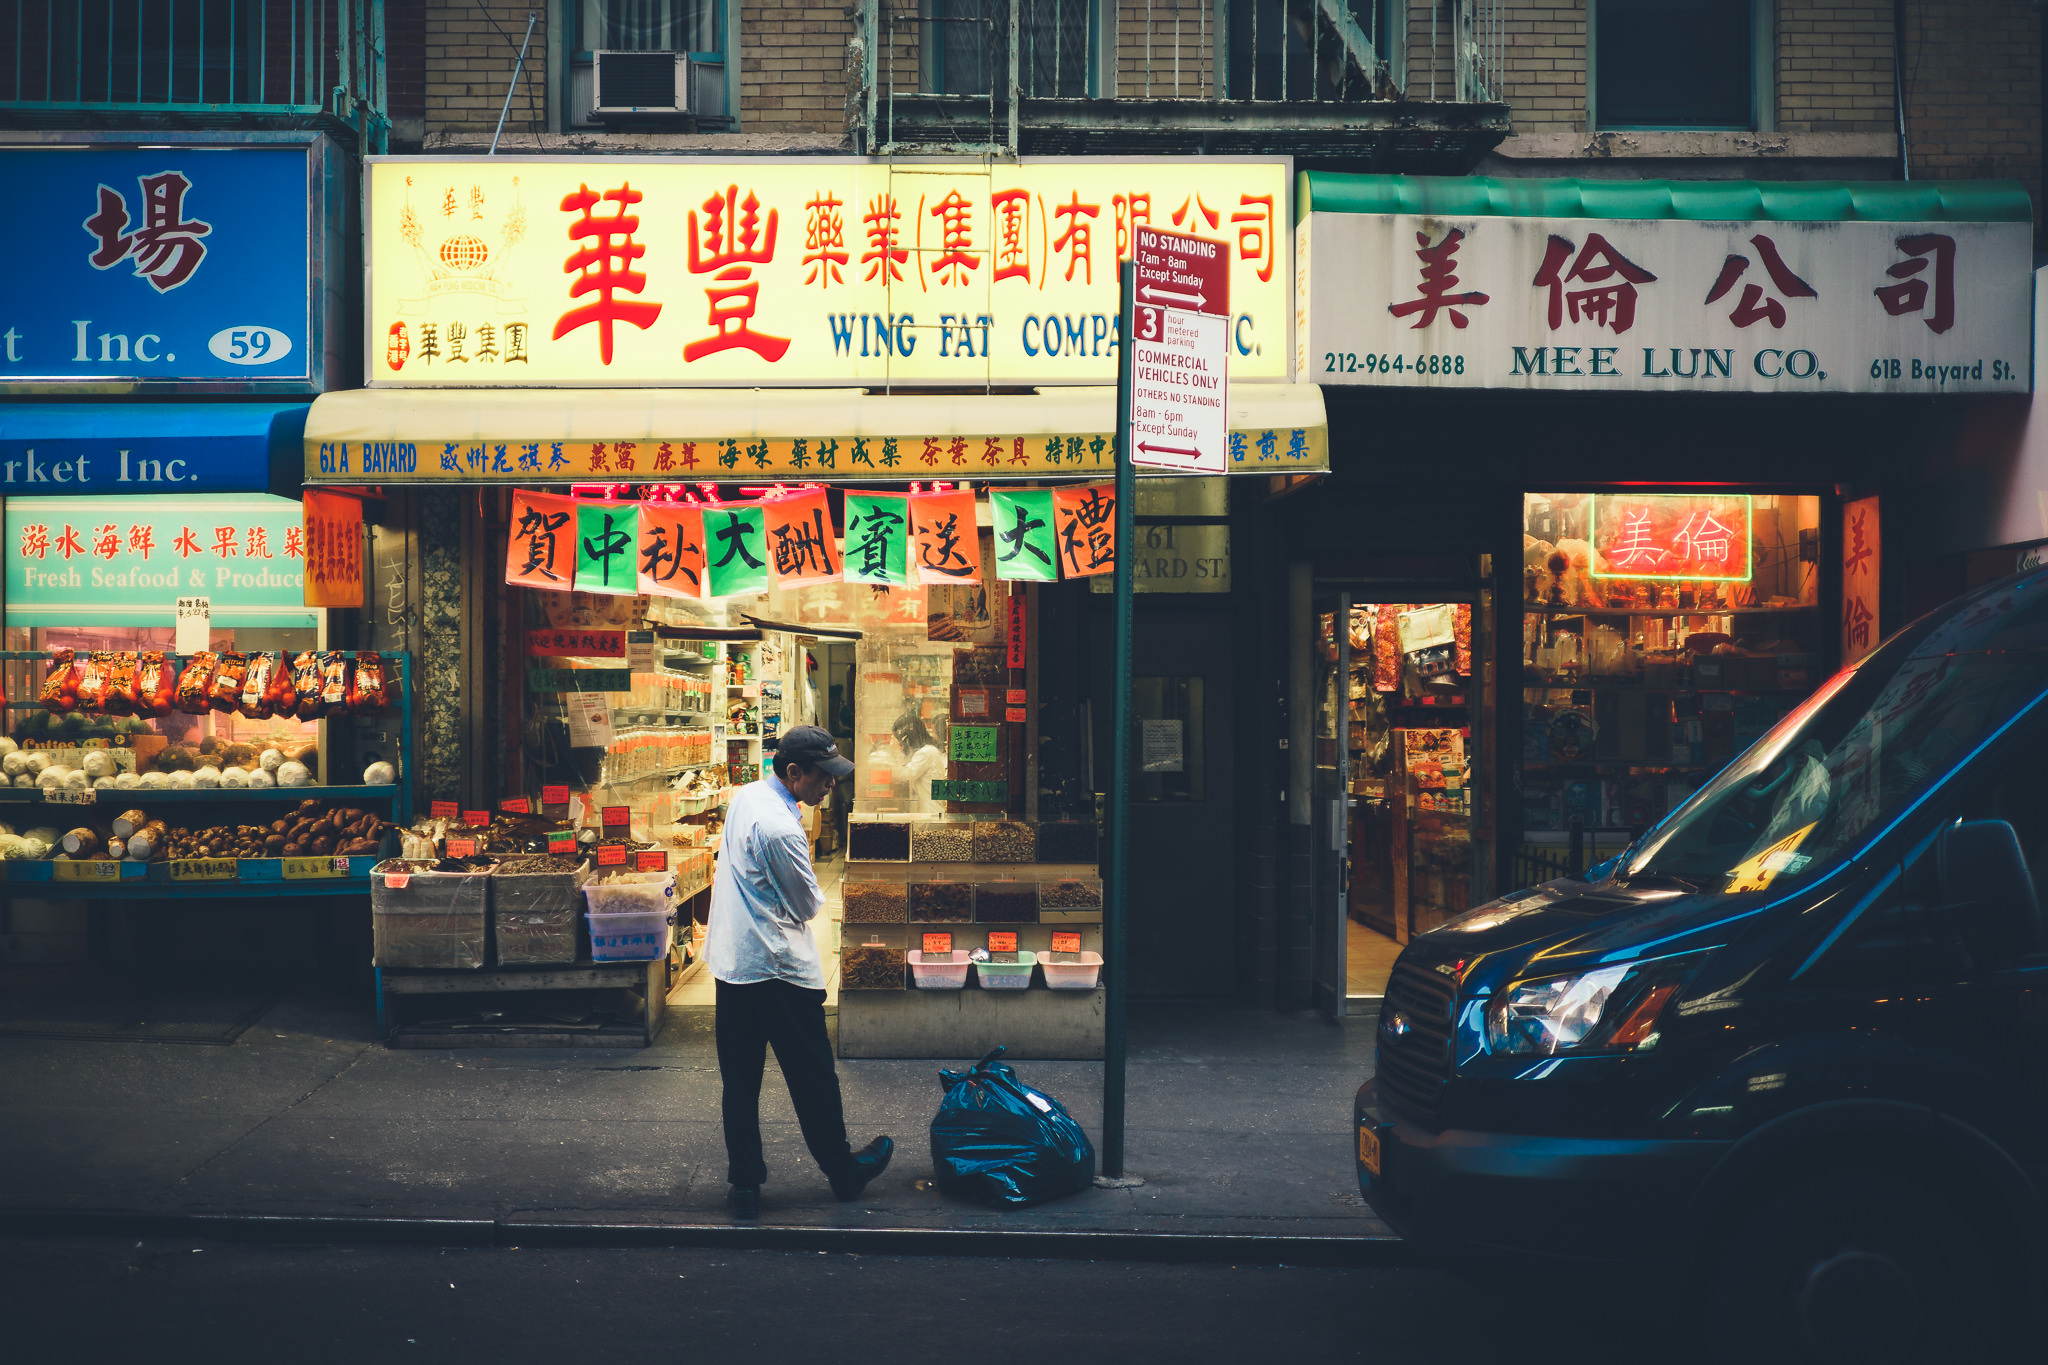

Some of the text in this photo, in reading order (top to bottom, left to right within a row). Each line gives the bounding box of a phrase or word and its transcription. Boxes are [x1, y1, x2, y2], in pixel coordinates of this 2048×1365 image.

[82, 170, 212, 294] 場
[1140, 232, 1216, 258] NO STANDING
[552, 181, 791, 364] 華豐
[1140, 251, 1159, 265] 7am
[1168, 255, 1187, 269] 8am
[1140, 266, 1203, 289] Except Sunday
[1388, 228, 1957, 334] 美倫公司
[1141, 307, 1157, 339] 3
[1168, 314, 1184, 325] hour
[1168, 325, 1199, 338] metered
[71, 320, 176, 363] Inc.
[229, 331, 271, 359] 59
[417, 320, 528, 366] 華豐集團
[827, 312, 917, 358] WING
[939, 312, 994, 358] FAT
[1022, 312, 1119, 357] COMPA
[1168, 336, 1195, 349] parking
[1138, 349, 1208, 371] COMMERCIAL
[1325, 352, 1465, 375] 212-964-6888
[1509, 346, 1623, 377] MEE
[1642, 347, 1736, 379] LUN
[1870, 359, 2016, 385] 61B Bayard St.
[1138, 366, 1219, 389] VEHICLES ONLY
[1137, 388, 1220, 408] OTHERS NO STANDING
[1136, 406, 1156, 419] 8am
[1164, 409, 1183, 423] 6pm
[1136, 420, 1198, 440] Except Sunday
[363, 442, 417, 473] BAYARD
[653, 441, 700, 471] 鹿茸
[718, 438, 772, 469] 海味
[788, 437, 839, 469] 藥材
[851, 436, 902, 469] 成藥
[981, 436, 1030, 467] 茶具
[1229, 430, 1310, 462] 客煎藥
[116, 449, 199, 483] Inc.
[20, 524, 156, 560] 游水海鮮
[172, 525, 304, 560] 水果蔬菜
[1146, 524, 1177, 550] 61
[1612, 508, 1734, 567] 美倫
[24, 566, 304, 588] Fresh Seafood & Produce
[1195, 557, 1228, 578] ST.
[1844, 507, 1874, 650] 美倫
